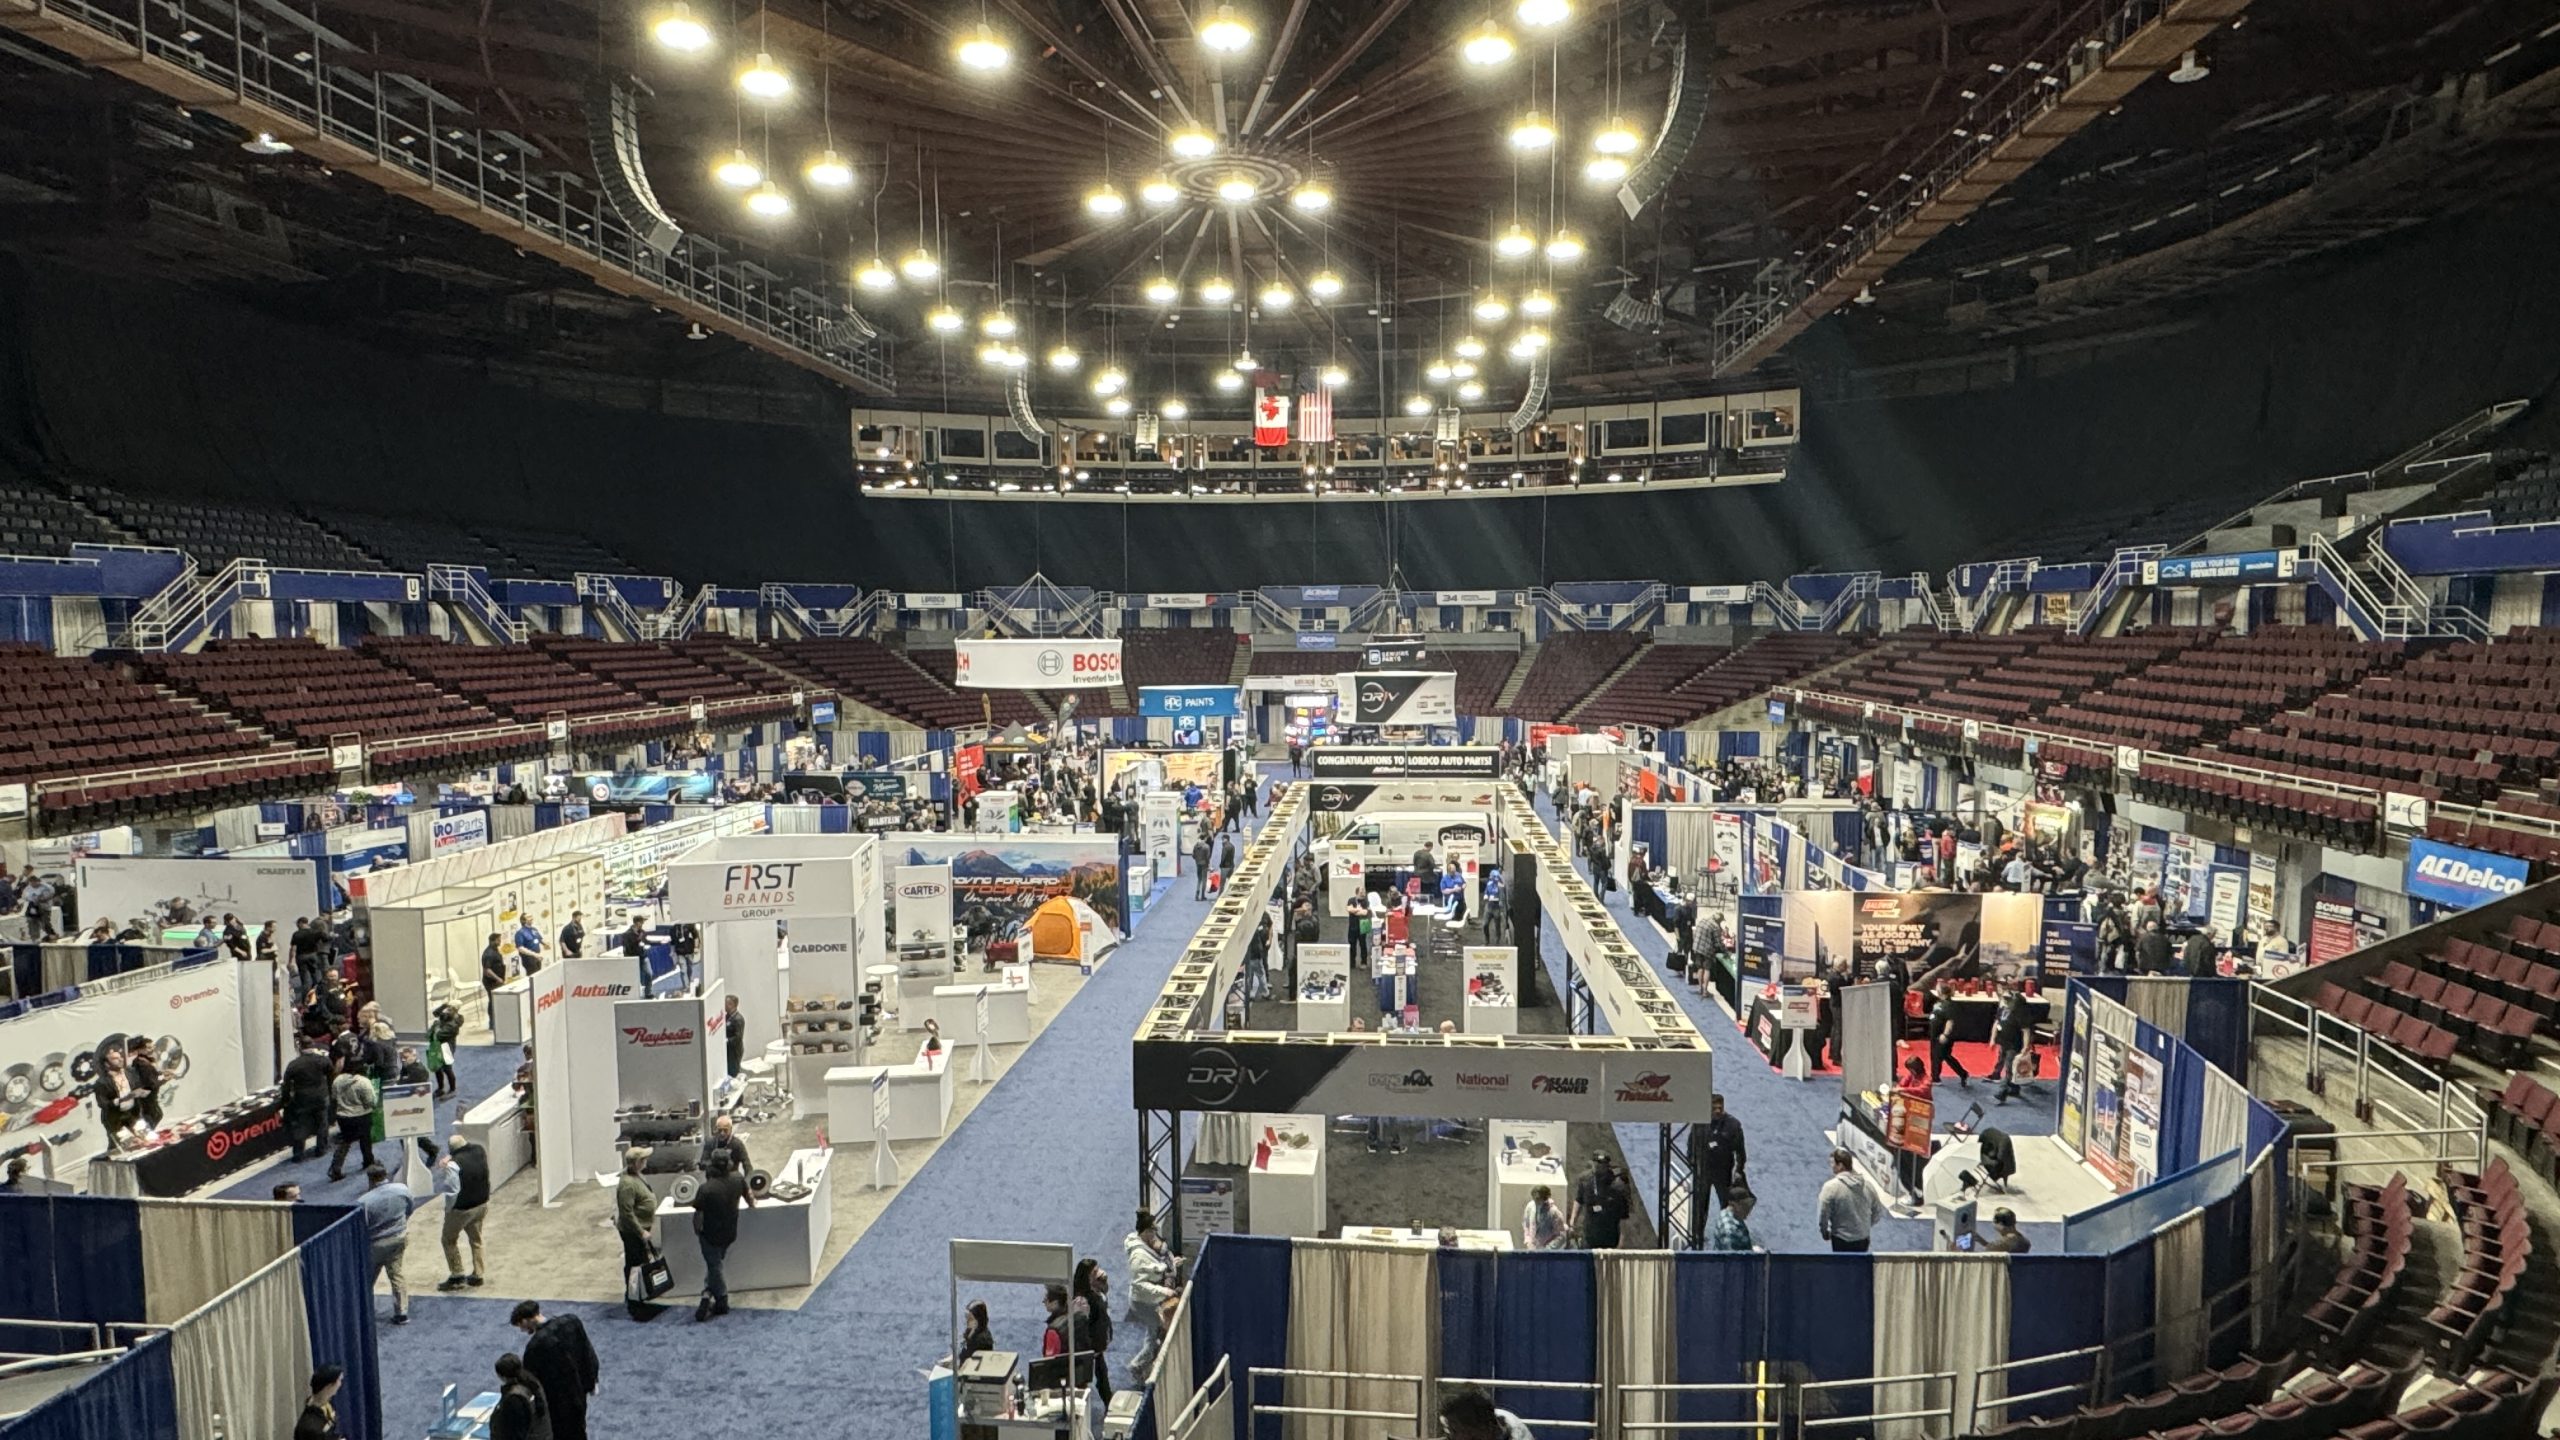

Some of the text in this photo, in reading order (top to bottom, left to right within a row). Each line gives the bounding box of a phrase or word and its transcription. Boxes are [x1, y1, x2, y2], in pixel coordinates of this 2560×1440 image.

[2147, 565, 2155, 575] G
[409, 580, 417, 593] U
[1073, 653, 1121, 672] BOSCH
[1185, 697, 1215, 708] PAINTS
[1317, 755, 1493, 766] CONGRATULATIONS TO LORDCO AUTO PARTS!
[460, 817, 484, 832] Parts
[257, 867, 306, 875] SCHAEFFLER
[2416, 854, 2525, 895] ACDelco
[903, 884, 941, 896] CARTER
[723, 891, 795, 906] BRANDS
[742, 909, 777, 918] GROUP
[1861, 924, 1925, 932] YOU'RE ONLY
[792, 943, 848, 954] CARDONE
[183, 986, 220, 1004] brembo
[571, 984, 632, 998] Autolite
[537, 985, 564, 1014] FRAM
[1456, 1073, 1509, 1086] National
[1549, 1077, 1589, 1087] SEALED
[1549, 1085, 1587, 1094] POWER
